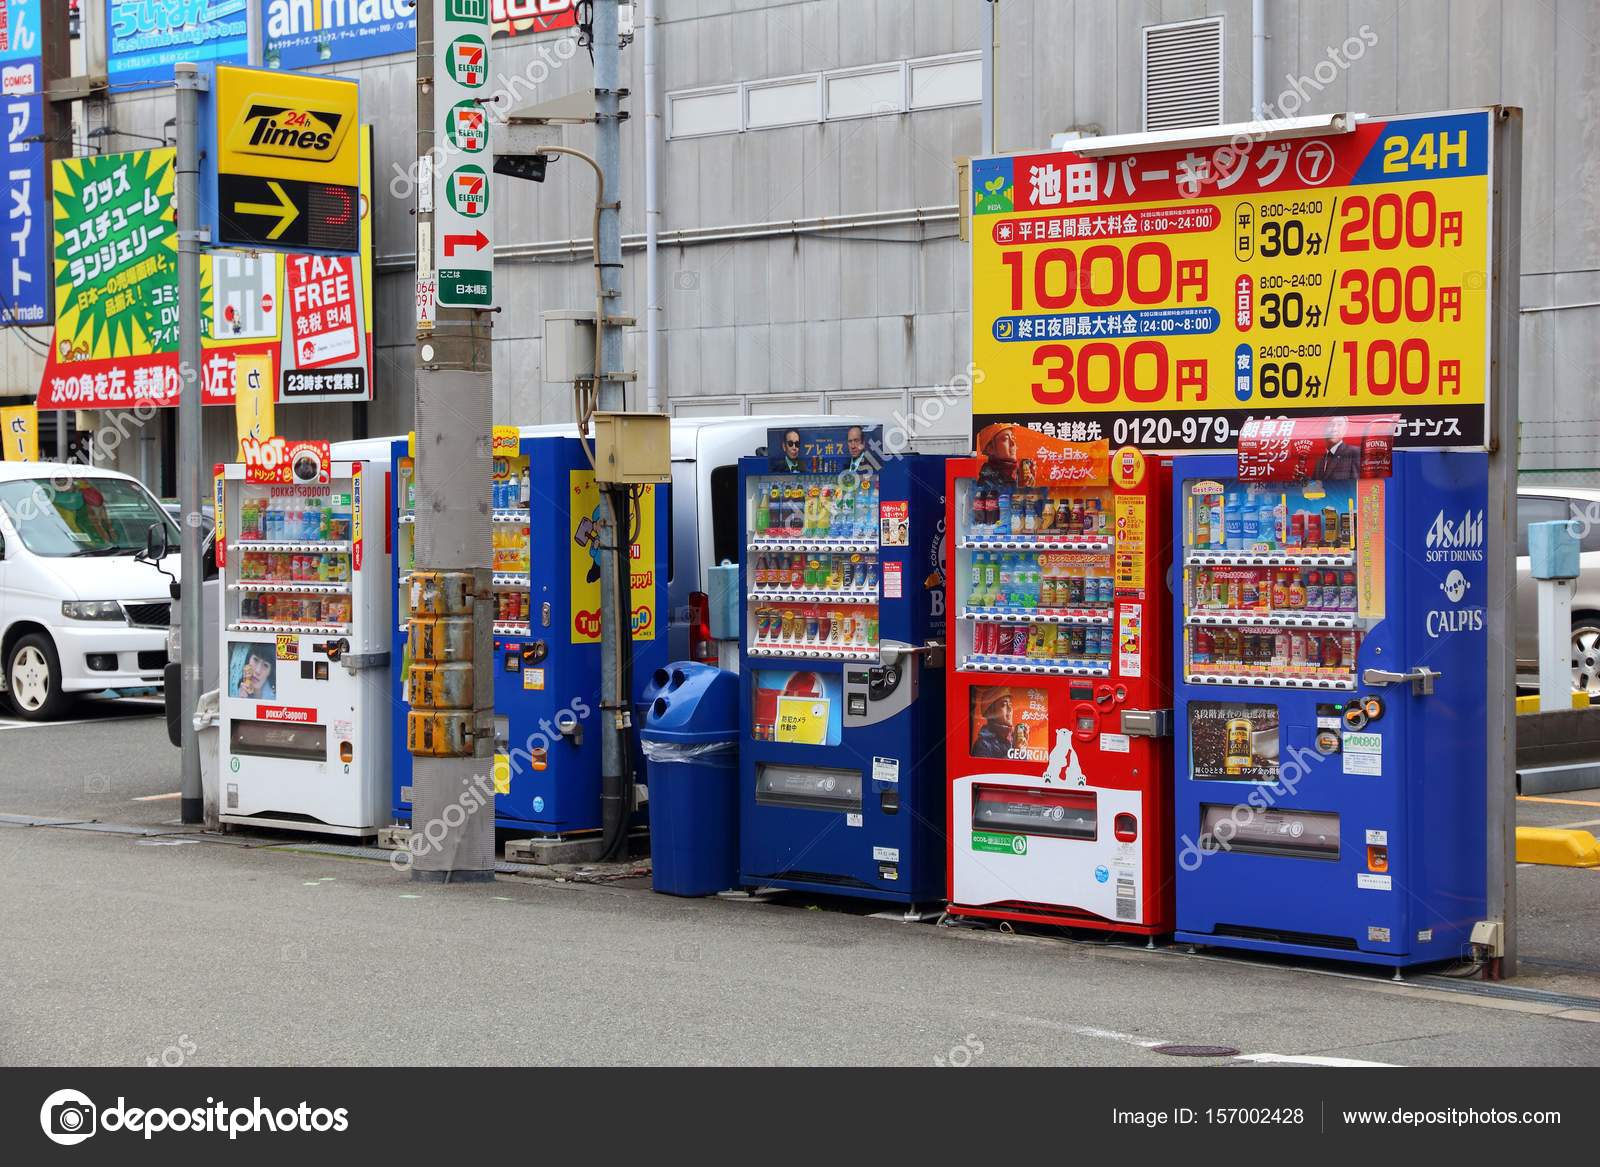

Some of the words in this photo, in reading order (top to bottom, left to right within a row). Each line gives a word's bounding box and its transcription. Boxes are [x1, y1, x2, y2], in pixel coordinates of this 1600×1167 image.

[4, 75, 32, 89] COMICS
[284, 112, 311, 127] 24h
[249, 118, 332, 150] Times
[1383, 130, 1468, 174] 24H
[8, 102, 32, 296] アニメイト
[82, 164, 131, 213] グッズ
[64, 187, 160, 256] コスチューム
[1261, 201, 1323, 217] 8:00～24:00
[1019, 213, 1138, 240] 平日昼間最大料金
[1238, 214, 1251, 250] 平日
[1260, 220, 1322, 257] 30分
[1340, 191, 1463, 252] 200円
[70, 225, 164, 288] ランジェリー
[295, 257, 343, 283] TAX
[440, 270, 461, 279] ここは
[1002, 241, 1208, 310] 1000円
[1260, 273, 1322, 289] 8:00～24:00
[293, 275, 352, 312] FREE
[456, 283, 487, 295] 日本橋西
[1237, 279, 1251, 326] 土日祝
[1260, 292, 1322, 329] 30分
[1339, 266, 1462, 325] 300円
[2, 301, 44, 321] animate
[297, 312, 321, 335] 免税
[420, 308, 428, 320] A
[1018, 314, 1138, 338] 終日夜間最大料金
[1259, 344, 1322, 358] 24:00～8:00
[287, 373, 360, 391] 23時まで営業！
[1031, 340, 1209, 404] 300円
[1237, 355, 1251, 391] 夜間
[1260, 362, 1322, 399] 60分
[1343, 338, 1461, 396] 100円
[1113, 415, 1288, 444] 0120-979-
[1241, 420, 1296, 438] 朝専用
[242, 438, 286, 470] HOT
[1239, 450, 1289, 464] モーニング
[1260, 438, 1291, 451] ワンダ
[1239, 463, 1276, 477] ショット
[298, 485, 331, 497] sapporo
[1426, 509, 1483, 548] Asahi
[1426, 550, 1450, 562] SOFT
[1451, 549, 1483, 561] DRINKS
[1426, 609, 1482, 638] CALPIS
